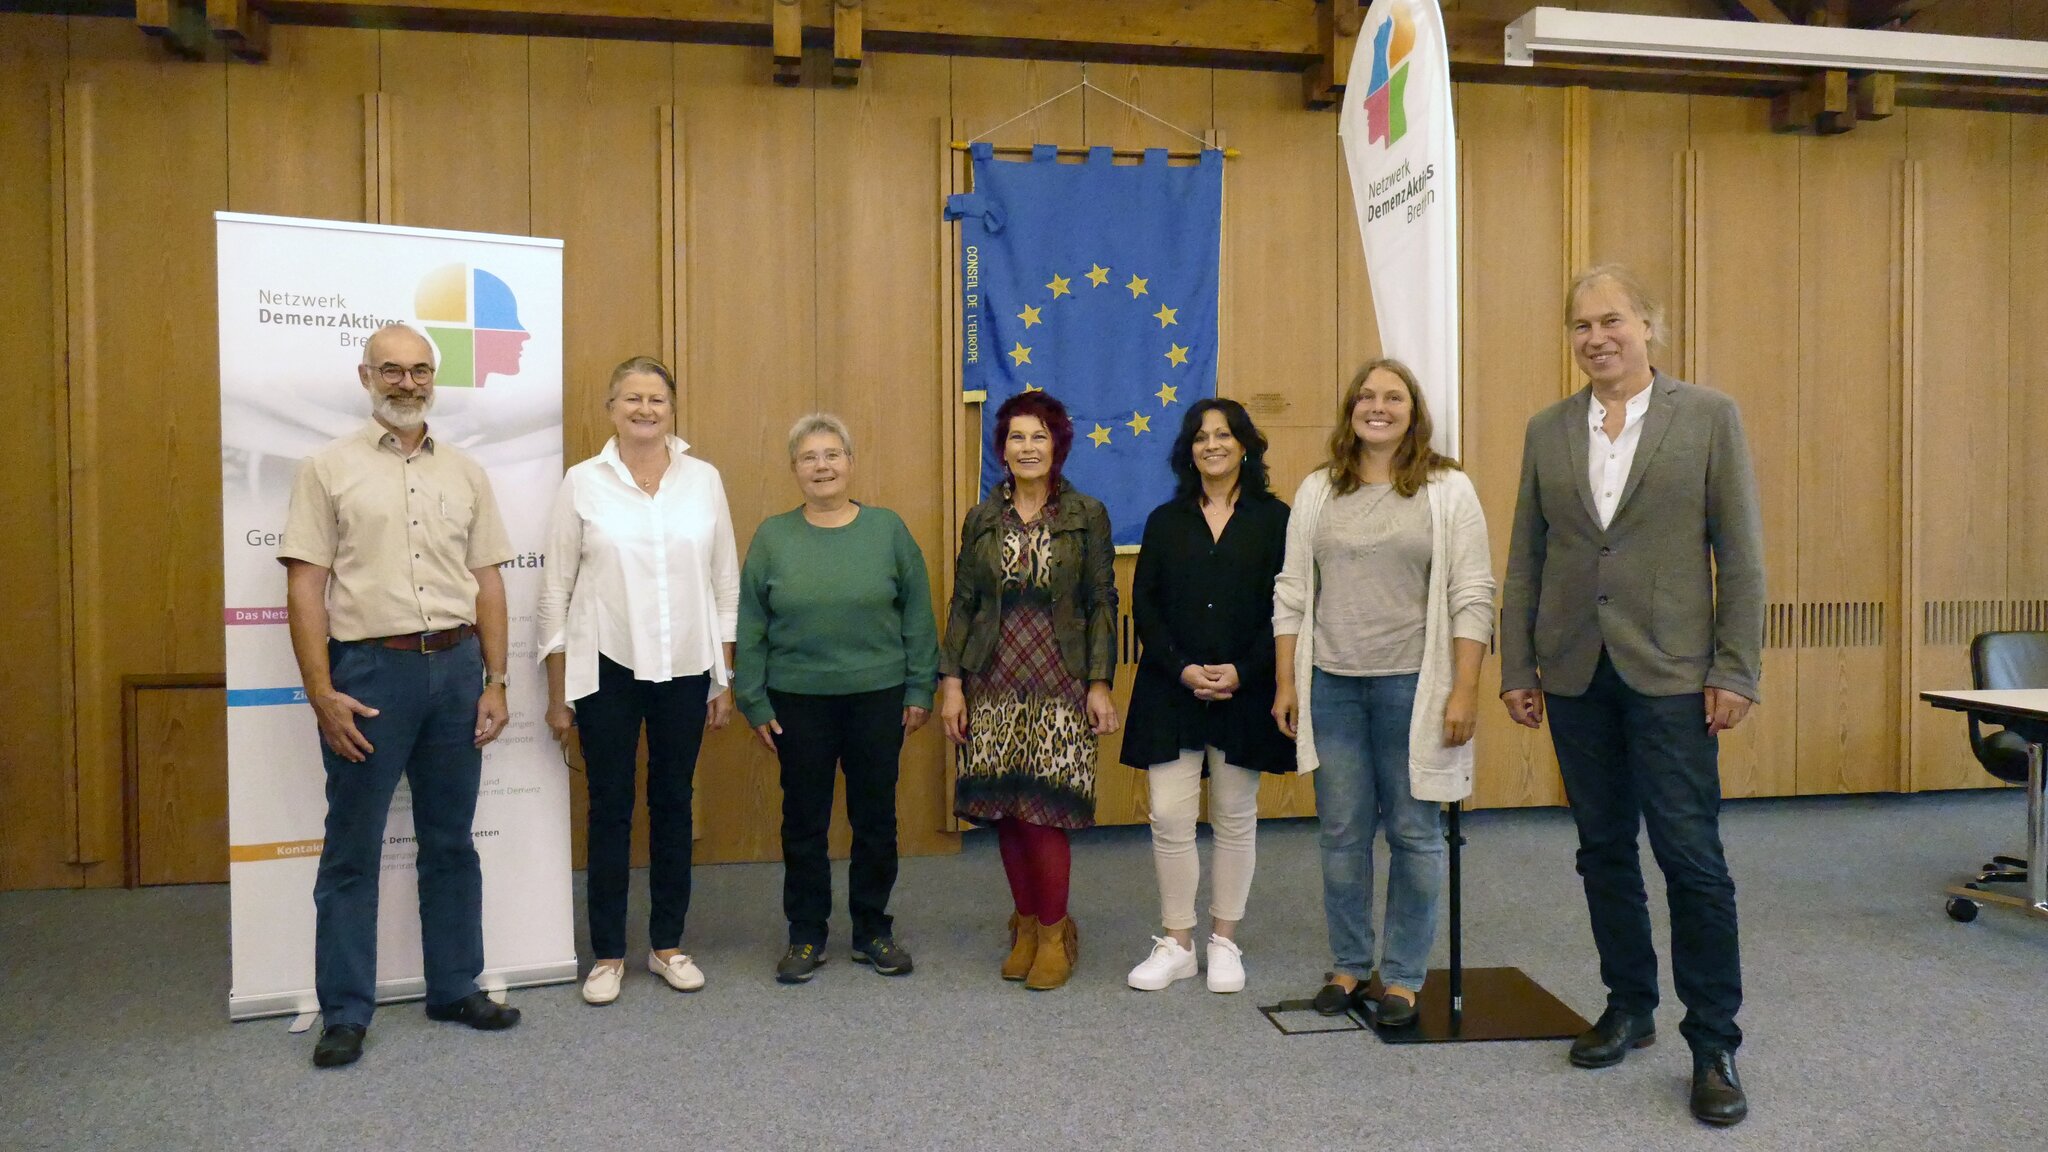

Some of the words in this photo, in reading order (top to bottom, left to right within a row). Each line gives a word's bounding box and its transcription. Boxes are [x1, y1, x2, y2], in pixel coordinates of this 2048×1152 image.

[1368, 158, 1411, 201] Netzwerk
[966, 246, 978, 291] CONSEIL
[259, 289, 347, 309] Netzwerk
[966, 294, 978, 309] DE
[967, 314, 978, 364] L'EUROPE
[236, 610, 258, 620] Das
[262, 608, 289, 620] Netz
[506, 785, 541, 796] Demenz
[470, 829, 500, 838] retten
